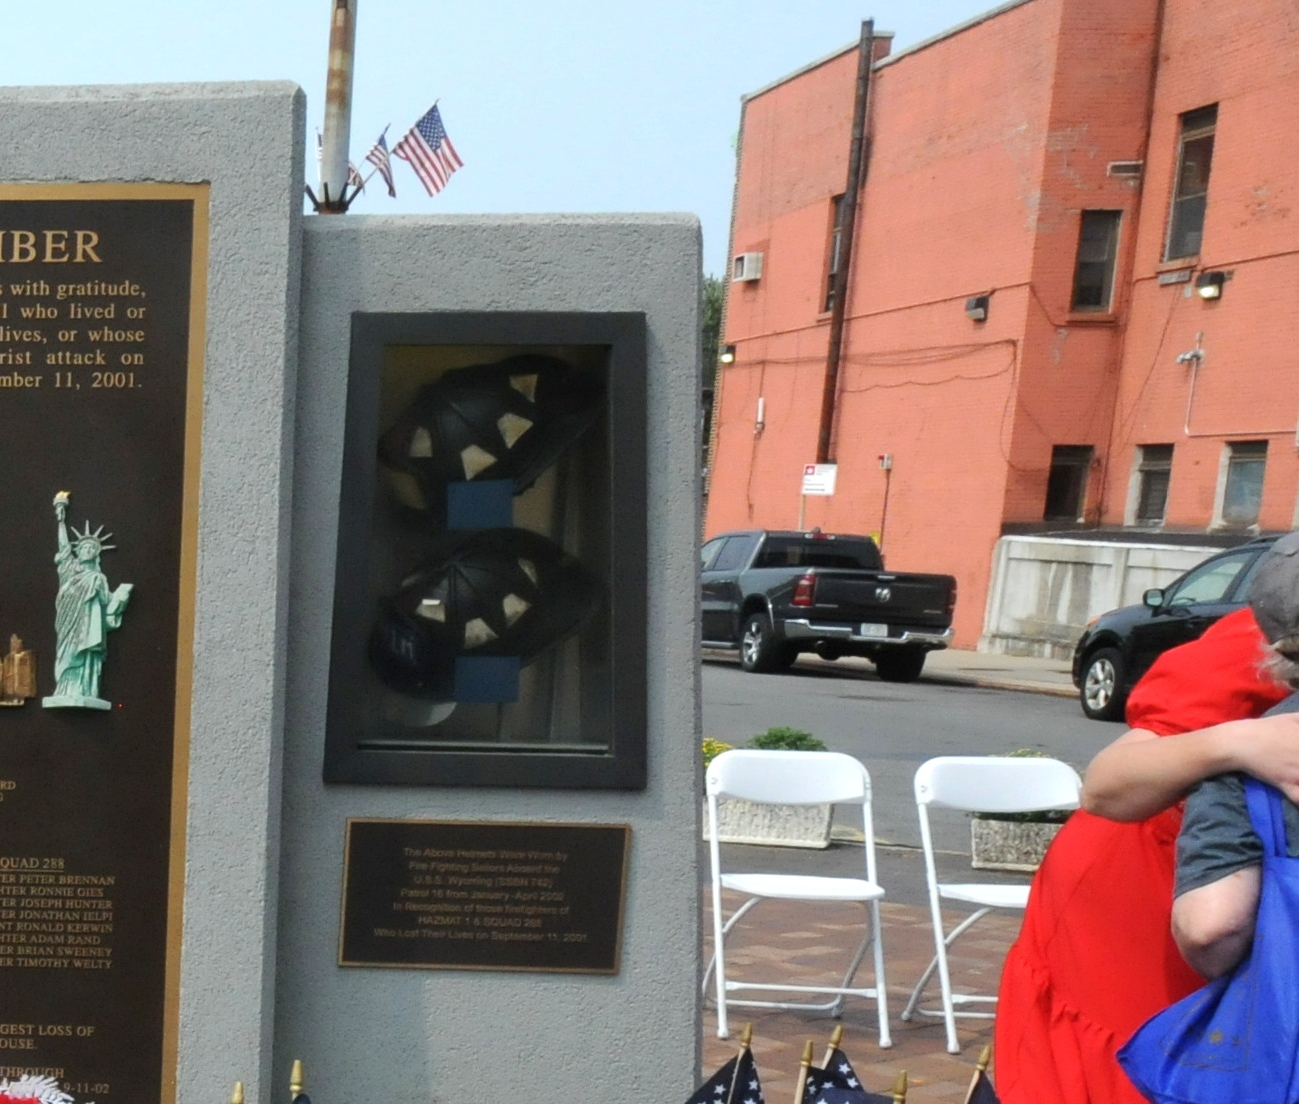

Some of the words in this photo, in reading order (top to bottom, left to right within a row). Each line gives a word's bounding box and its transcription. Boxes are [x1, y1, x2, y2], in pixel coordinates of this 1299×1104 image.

[10, 280, 49, 295] with
[56, 280, 145, 299] gratitude,
[20, 303, 57, 318] who
[70, 303, 114, 318] lived
[127, 308, 145, 318] or
[0, 326, 46, 343] lives,
[58, 330, 77, 341] or
[88, 326, 144, 341] whose
[46, 349, 104, 364] attack
[121, 354, 143, 364] on
[55, 372, 79, 389] 11,
[92, 372, 141, 387] 2001.
[43, 858, 63, 868] 288
[19, 874, 54, 883] PETER
[59, 875, 114, 884] BRENNAN
[16, 957, 69, 967] TIMOTHY
[73, 959, 111, 968] WELTY
[39, 1025, 73, 1036] LOSS
[77, 1026, 95, 1037] OF
[0, 1066, 65, 1078] THROUGH
[63, 1082, 110, 1094] 9-11-02
